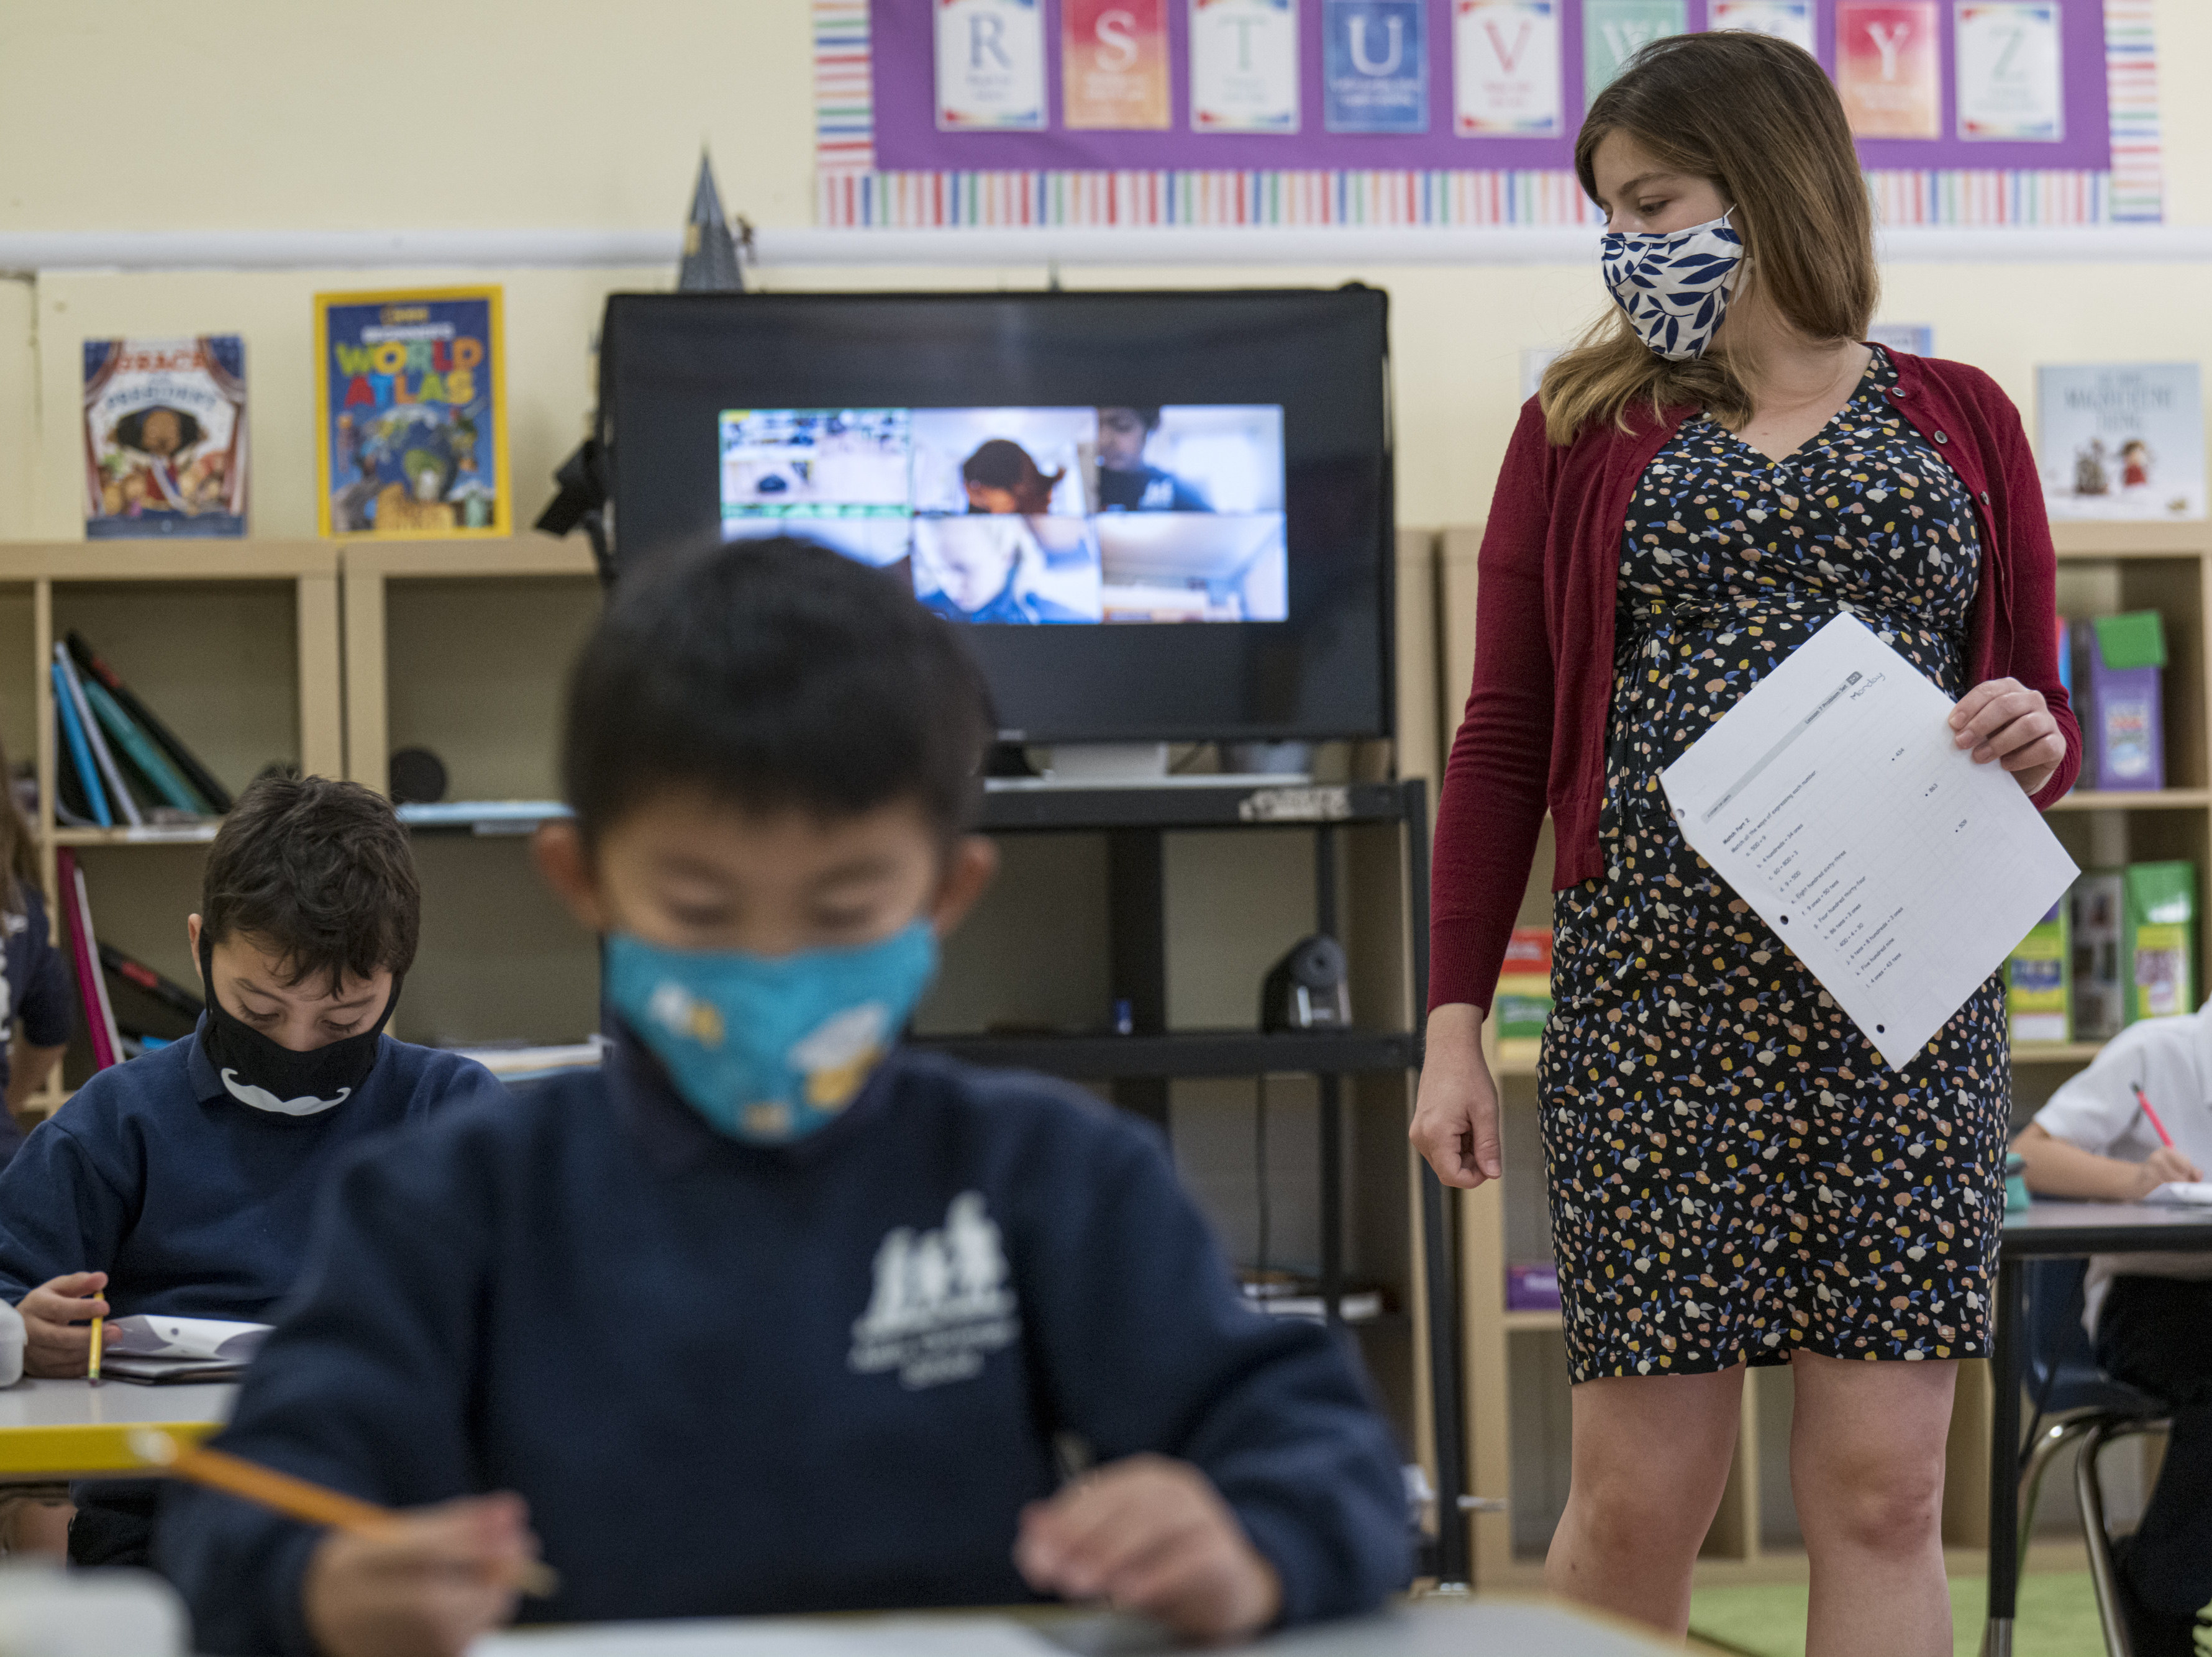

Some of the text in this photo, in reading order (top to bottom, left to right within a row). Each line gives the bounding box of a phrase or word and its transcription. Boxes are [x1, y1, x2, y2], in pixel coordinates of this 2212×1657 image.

[969, 11, 1013, 68] R
[1095, 9, 1137, 72] S
[1218, 12, 1270, 70] T
[1348, 14, 1403, 77] U
[1483, 19, 1533, 73] V
[1866, 22, 1910, 81] Y
[1990, 25, 2029, 82] Z
[336, 335, 483, 377] WORLD
[344, 371, 475, 408] ATLAS
[1805, 710, 1819, 724] Lesson
[1821, 691, 1840, 707] Problem
[1839, 684, 1847, 692] Set
[1849, 671, 1885, 702] Monday
[1895, 747, 1904, 756] 434
[1723, 831, 1736, 844] Match
[1736, 822, 1745, 831] Part
[1731, 840, 1744, 853] Match
[1757, 818, 1767, 828] ways
[1771, 793, 1793, 814] expressing
[1792, 784, 1801, 794] each
[1958, 819, 1967, 828] 509
[1750, 842, 1760, 851] 500
[1765, 840, 1785, 859] hundreds
[1793, 824, 1803, 833] ones
[1782, 856, 1791, 866] 800
[1791, 870, 1801, 880] 500
[1795, 887, 1808, 899] Eight
[1806, 871, 1824, 888] hundred
[1823, 850, 1847, 873] sixty-three
[1811, 897, 1821, 907] ones
[1829, 879, 1839, 889] tens
[1818, 912, 1828, 922] Four
[1827, 896, 1845, 913] hundred
[1843, 875, 1866, 897] thirty-four
[1836, 919, 1845, 928] tens
[1851, 903, 1861, 914] ones
[1854, 946, 1864, 955] tens
[1868, 922, 1888, 940] hundreds
[1893, 906, 1903, 917] ones
[1839, 938, 1848, 947] 400
[1860, 961, 1870, 970] Five
[1868, 945, 1887, 962] hundred
[1885, 937, 1894, 947] nine
[1873, 970, 1883, 980] ones
[1891, 952, 1901, 962] tens
